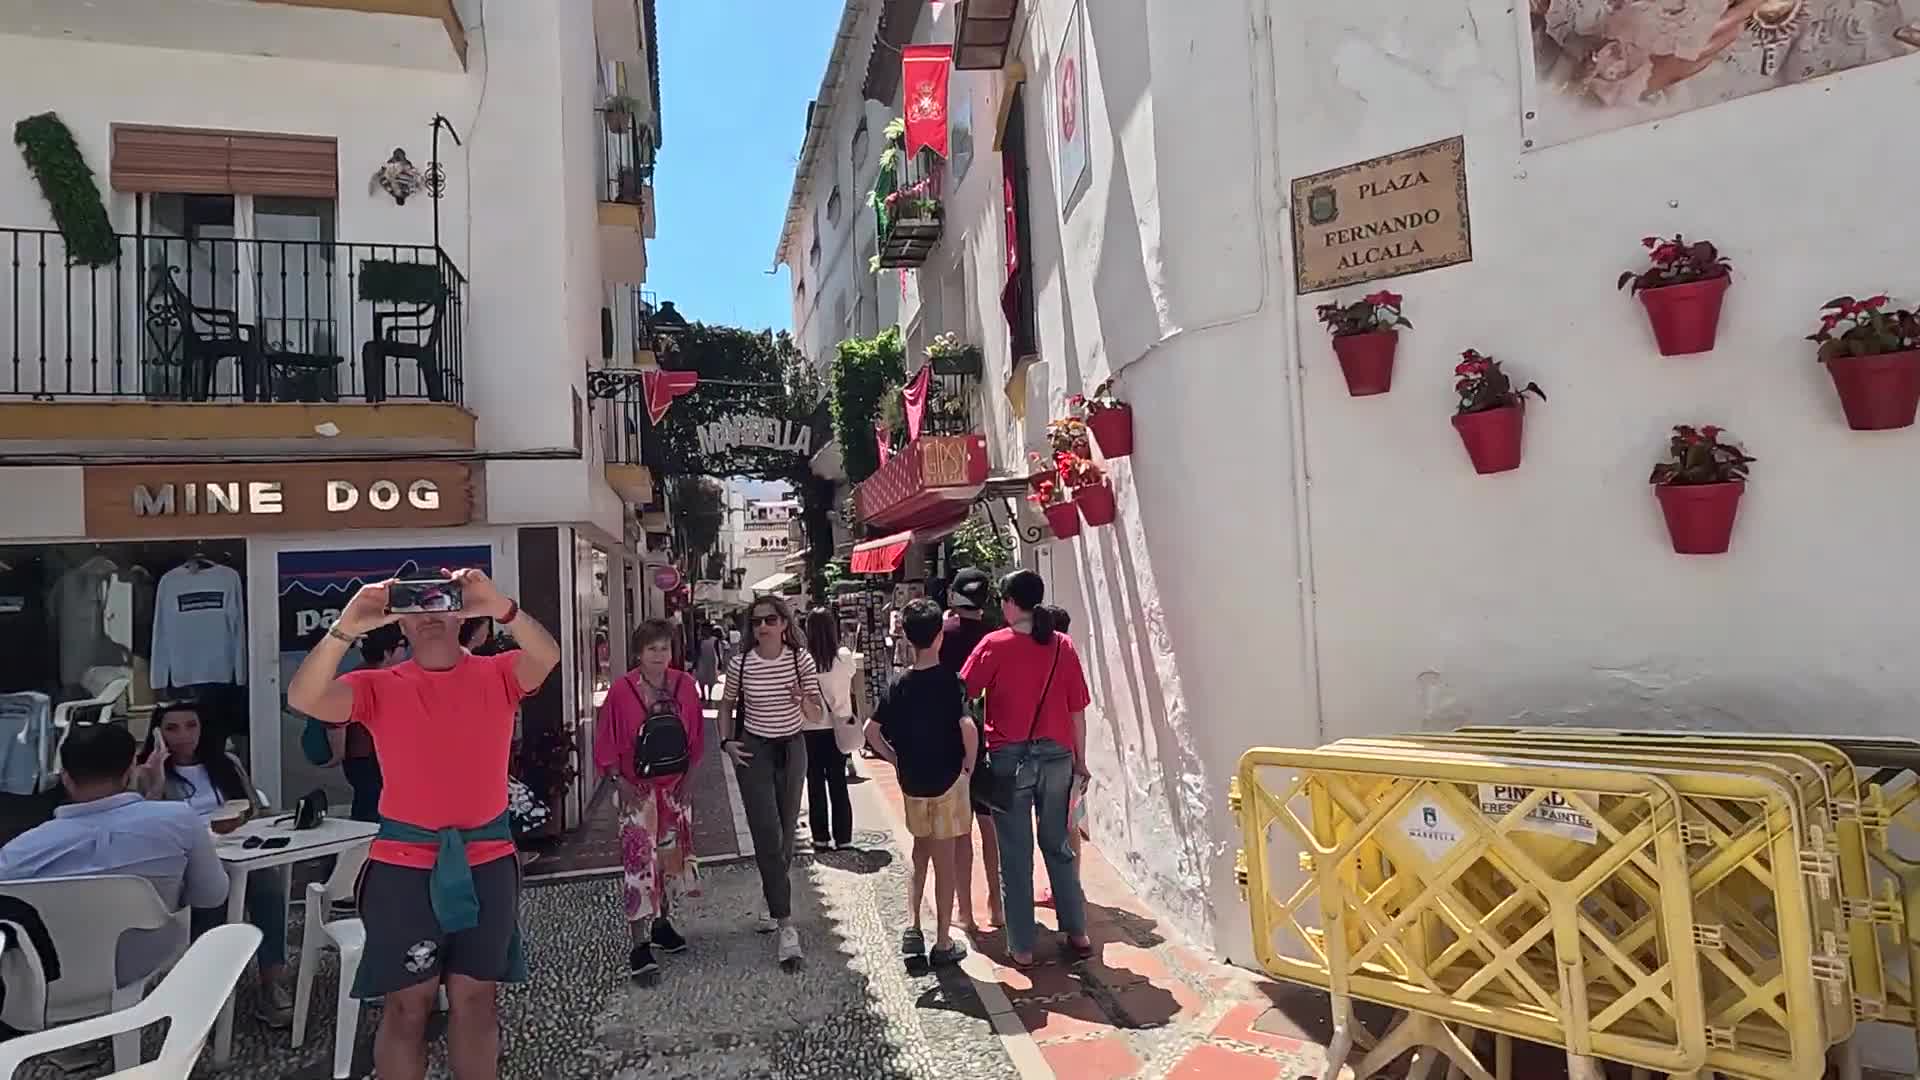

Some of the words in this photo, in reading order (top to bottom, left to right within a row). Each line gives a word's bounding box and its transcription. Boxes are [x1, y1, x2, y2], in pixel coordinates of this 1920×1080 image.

[1359, 171, 1430, 199] PLAZA
[1325, 209, 1440, 247] FERNANDO
[1337, 240, 1424, 270] ALCALA
[923, 439, 967, 478] GIPSY
[132, 482, 283, 517] MINE
[326, 479, 440, 512] DOG
[1408, 831, 1456, 842] MARBELLA
